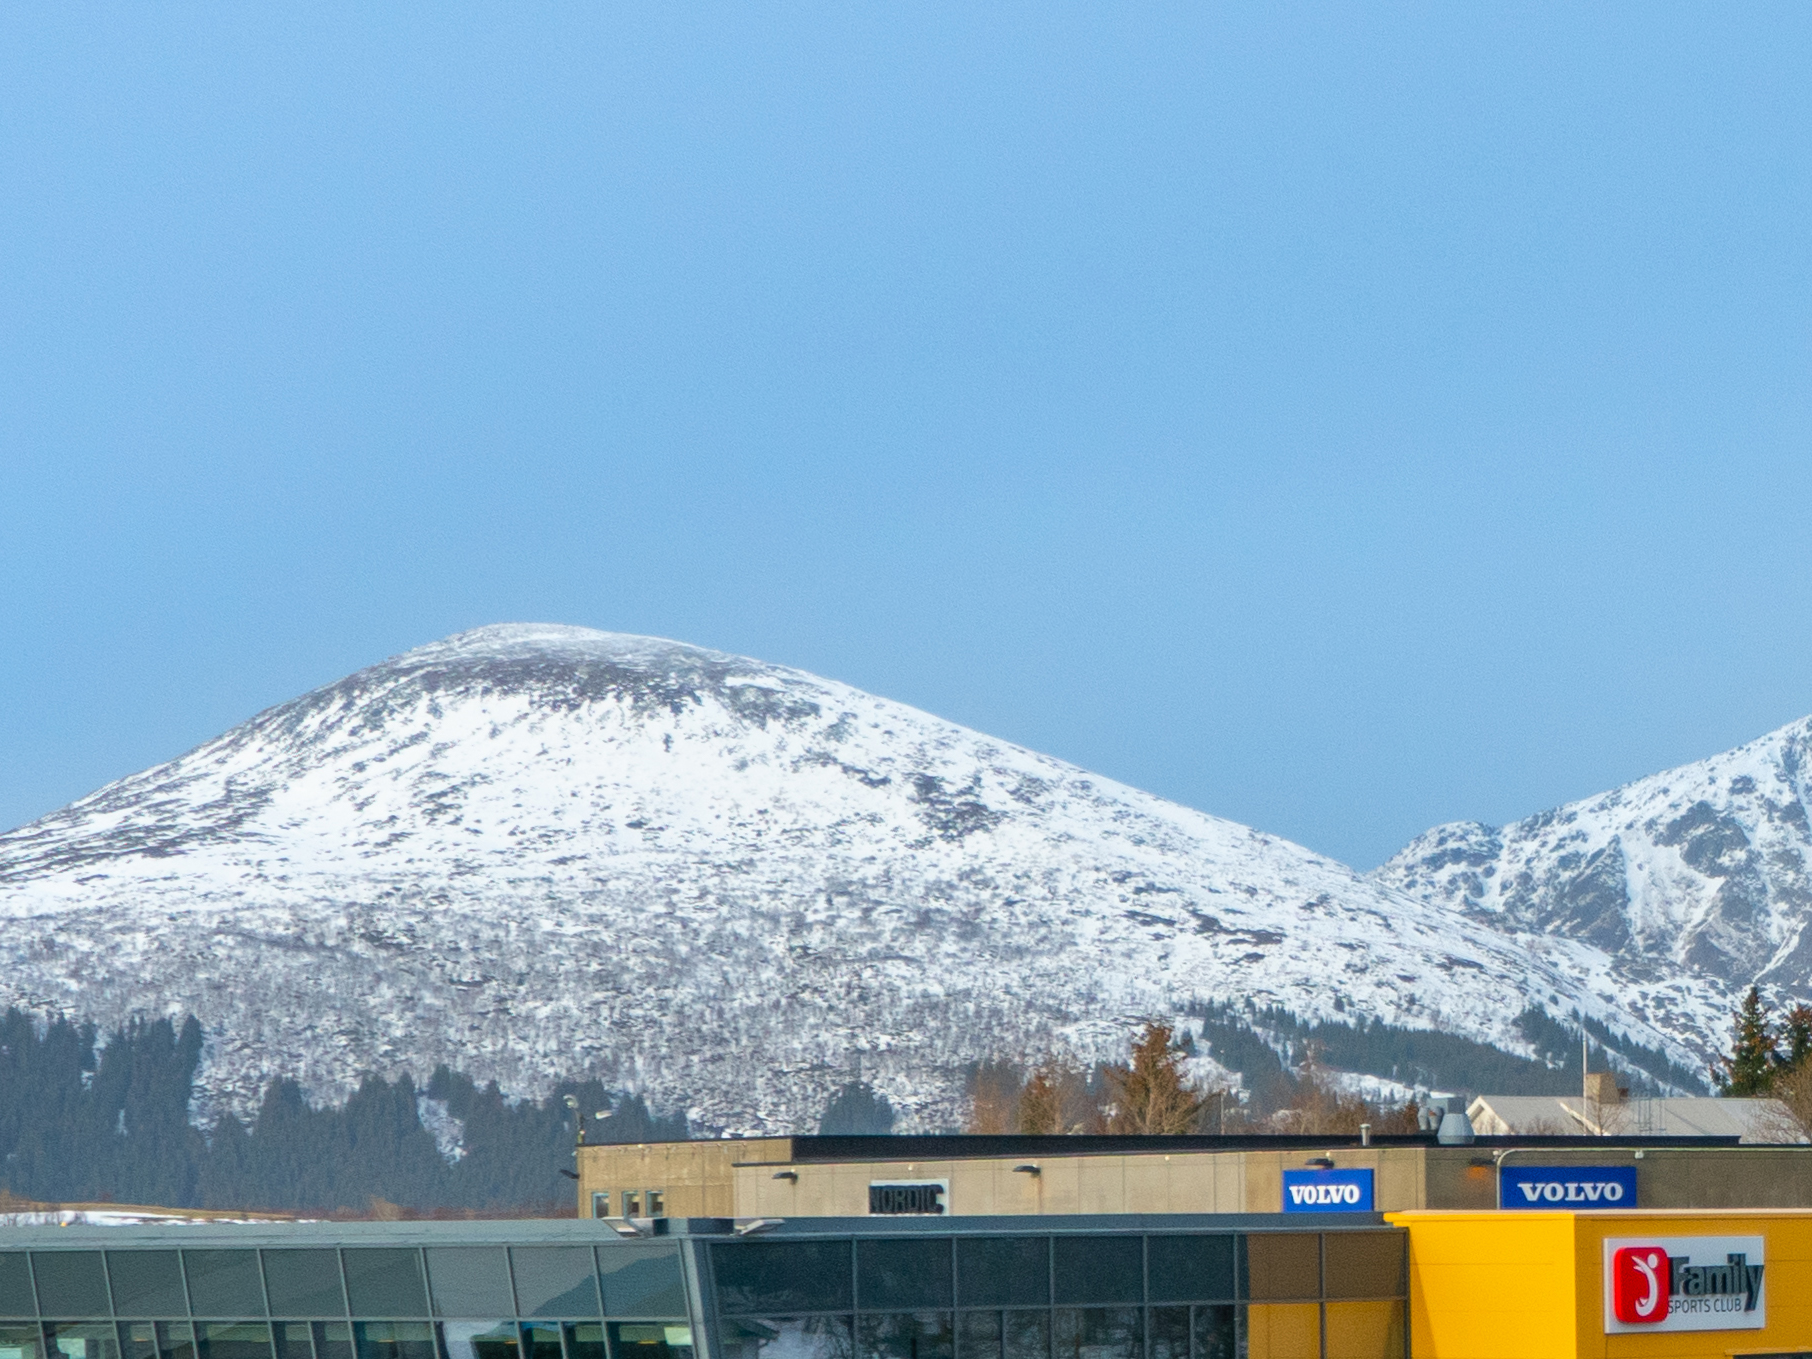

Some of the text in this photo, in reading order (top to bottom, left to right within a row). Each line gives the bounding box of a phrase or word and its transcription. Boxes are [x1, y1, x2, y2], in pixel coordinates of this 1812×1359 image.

[869, 1184, 944, 1214] NORDIC
[1289, 1185, 1360, 1204] VOLVO
[1518, 1182, 1623, 1202] VOLVO
[1669, 1253, 1765, 1313] Family
[1668, 1299, 1742, 1314] SPORTS CLUB
